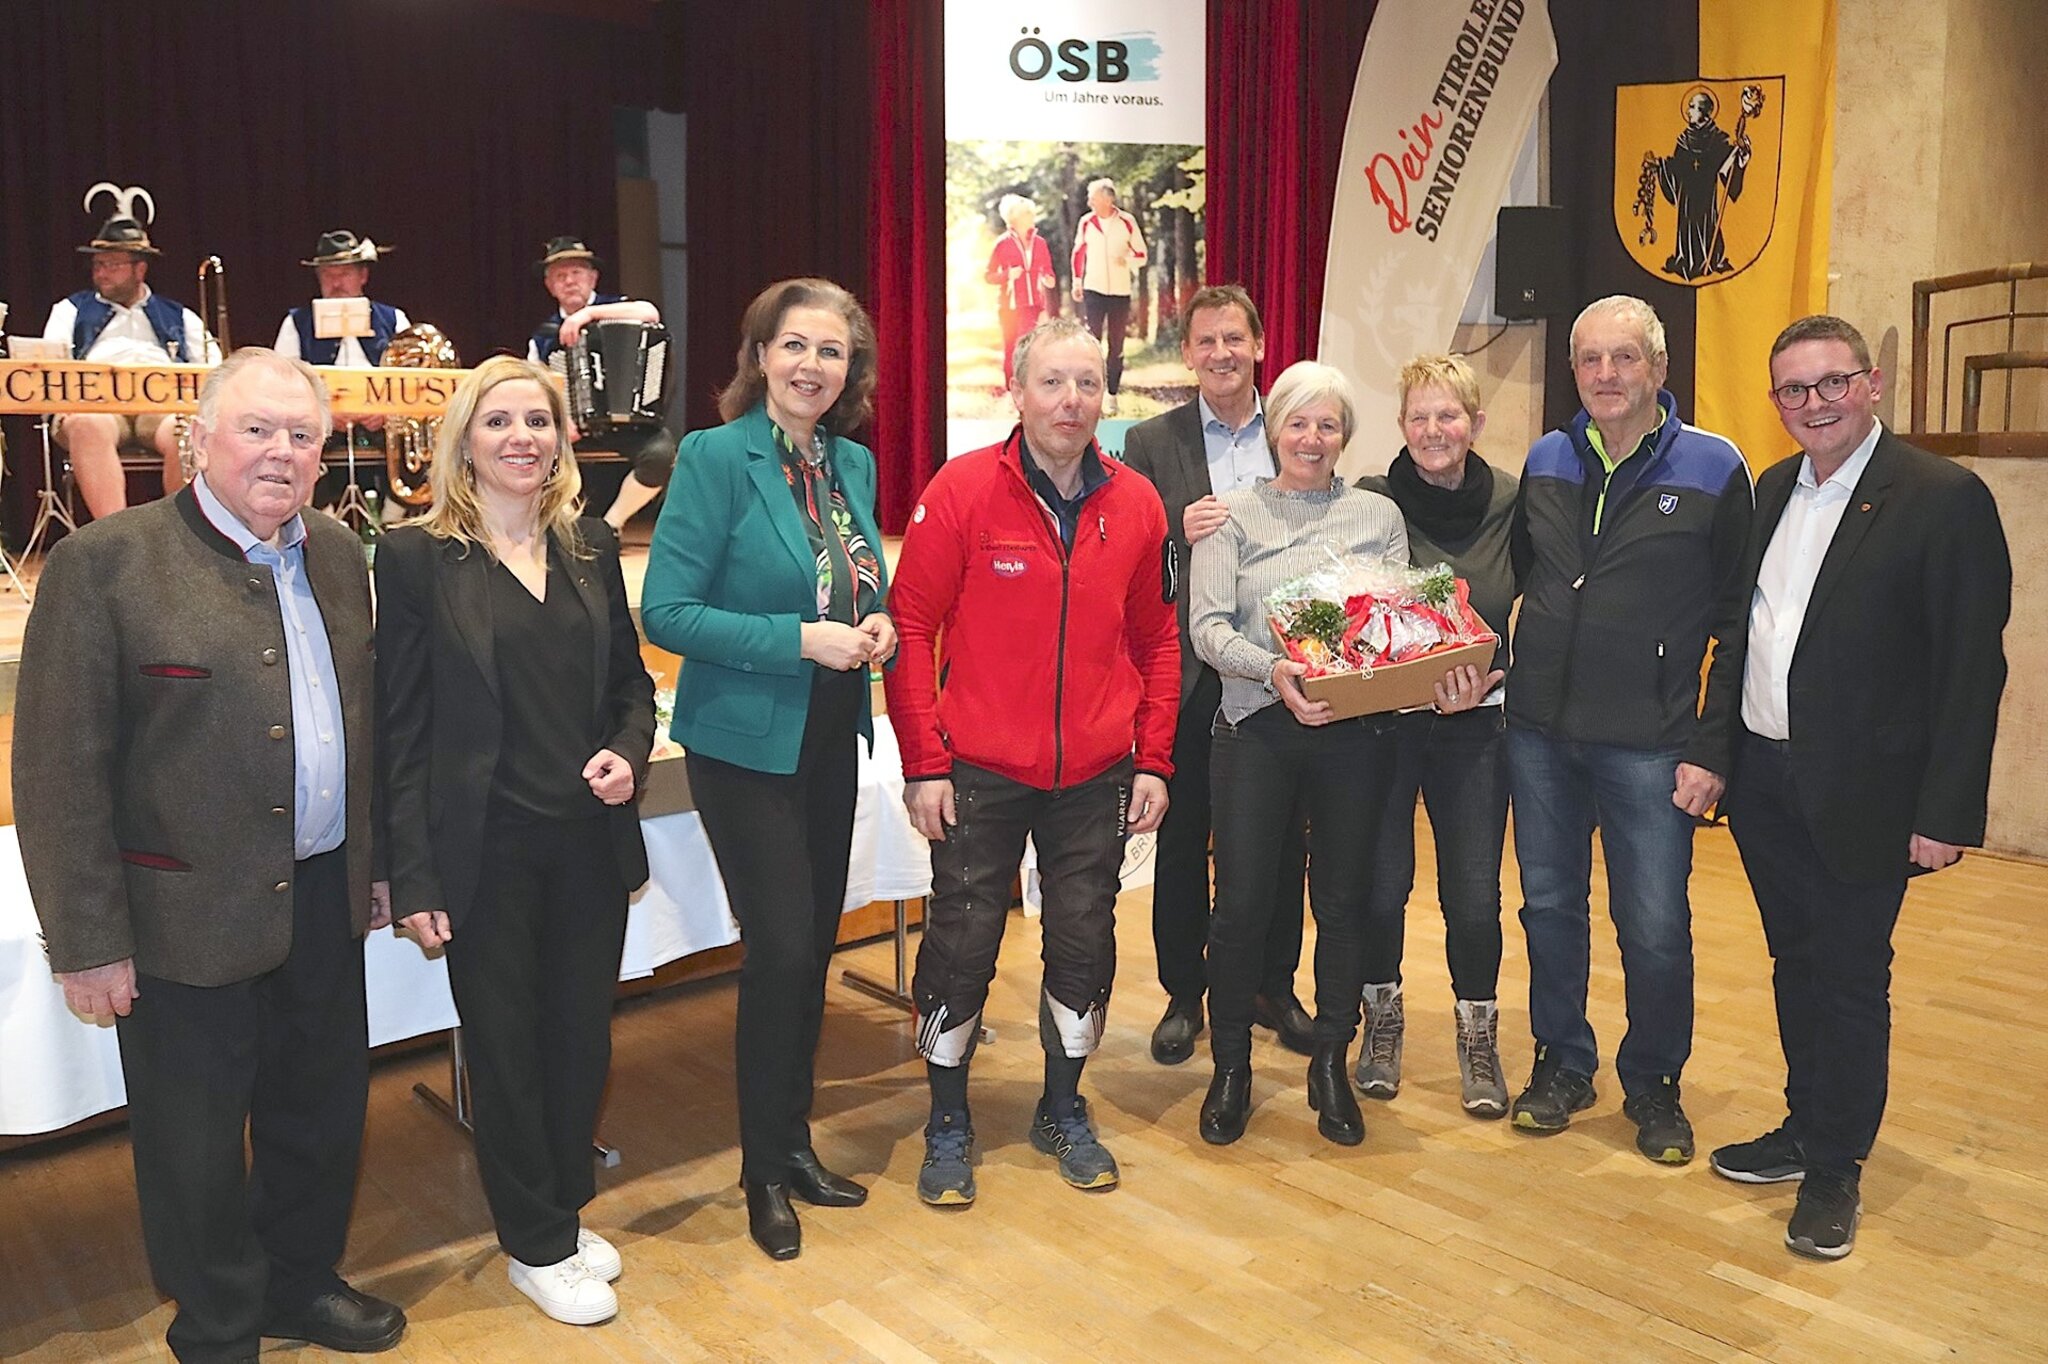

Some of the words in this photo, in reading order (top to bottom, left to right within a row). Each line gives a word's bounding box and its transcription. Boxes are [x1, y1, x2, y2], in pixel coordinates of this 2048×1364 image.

[1009, 26, 1129, 83] ÖSB
[1044, 91, 1068, 103] Um
[1072, 91, 1109, 105] Jahre
[1113, 95, 1163, 106] voraus.
[1364, 109, 1443, 234] Dein
[1431, 0, 1499, 112] TIROLE
[1415, 0, 1525, 243] SENIORENBUND
[0, 368, 200, 403] CHEUCH
[1117, 785, 1127, 837] VUARNET
